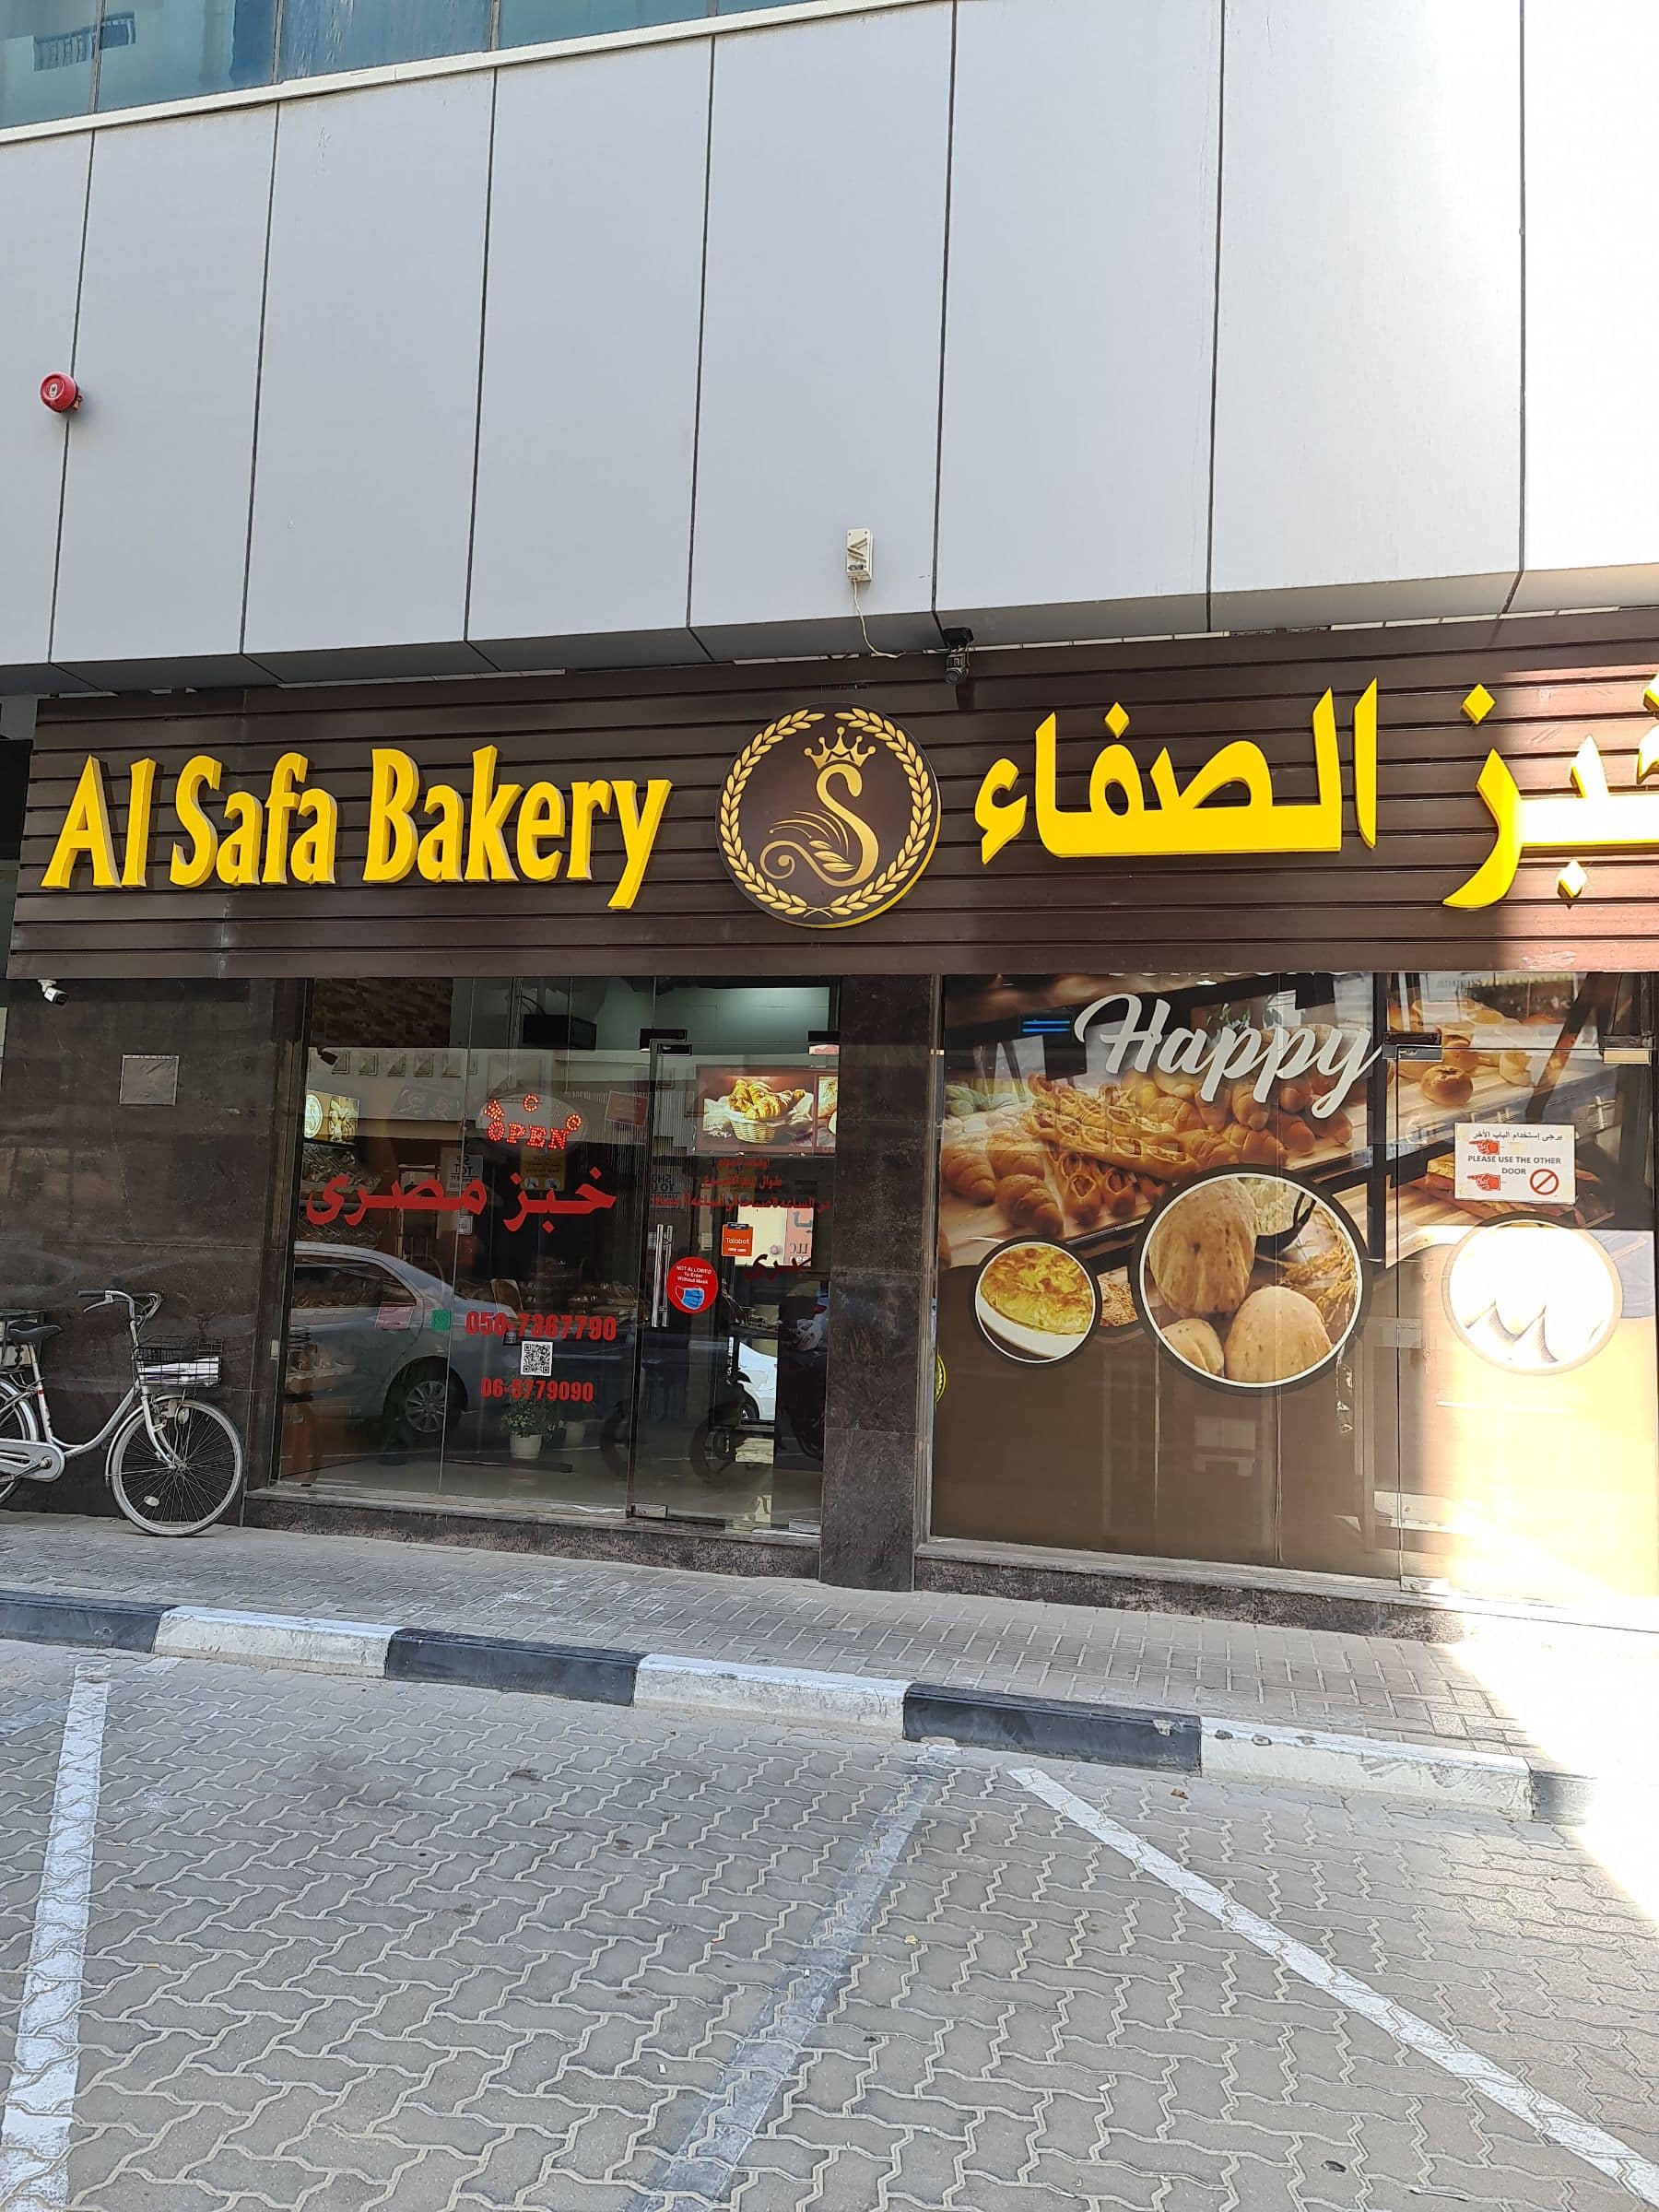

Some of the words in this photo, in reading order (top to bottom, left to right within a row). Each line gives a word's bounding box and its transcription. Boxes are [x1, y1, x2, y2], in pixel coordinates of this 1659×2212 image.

[974, 677, 1378, 865] الصفاء
[1441, 673, 1659, 910] بز
[40, 753, 157, 890] Al
[170, 751, 338, 888] Safa
[362, 744, 673, 911] Bakery
[1074, 993, 1382, 1119] Happy
[487, 1120, 570, 1150] OPEN
[1467, 1155, 1496, 1163] PLEASE
[1515, 1156, 1532, 1164] THE
[1533, 1157, 1561, 1165] OTHER
[306, 1174, 487, 1226] مصرى
[503, 1166, 617, 1233] خبز
[1501, 1167, 1526, 1175] DOOR
[480, 1377, 594, 1403] 06-5779090
